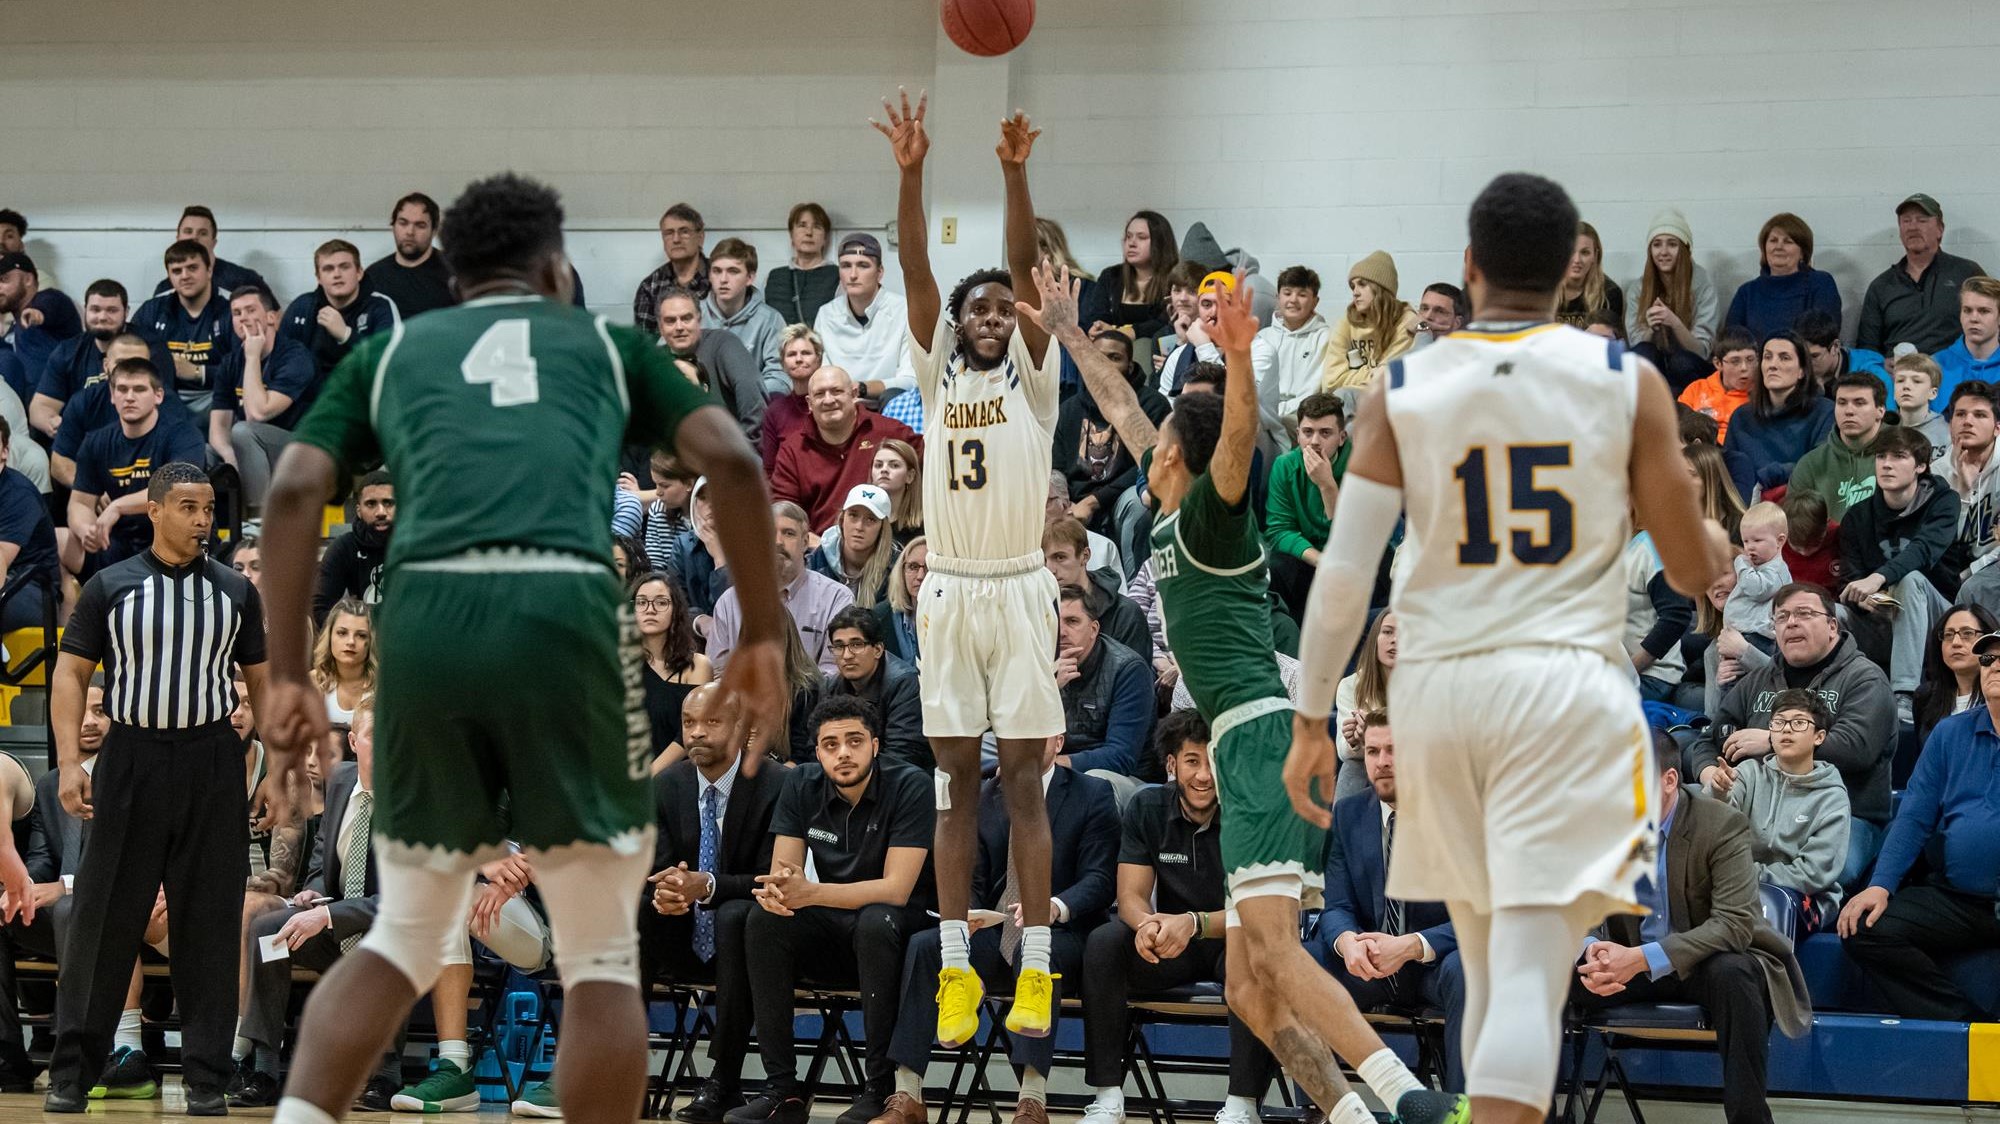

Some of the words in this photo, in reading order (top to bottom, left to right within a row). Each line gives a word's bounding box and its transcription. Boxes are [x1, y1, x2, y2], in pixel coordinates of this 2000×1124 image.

[461, 318, 540, 407] 4
[947, 438, 988, 491] 13
[1452, 441, 1576, 567] 15
